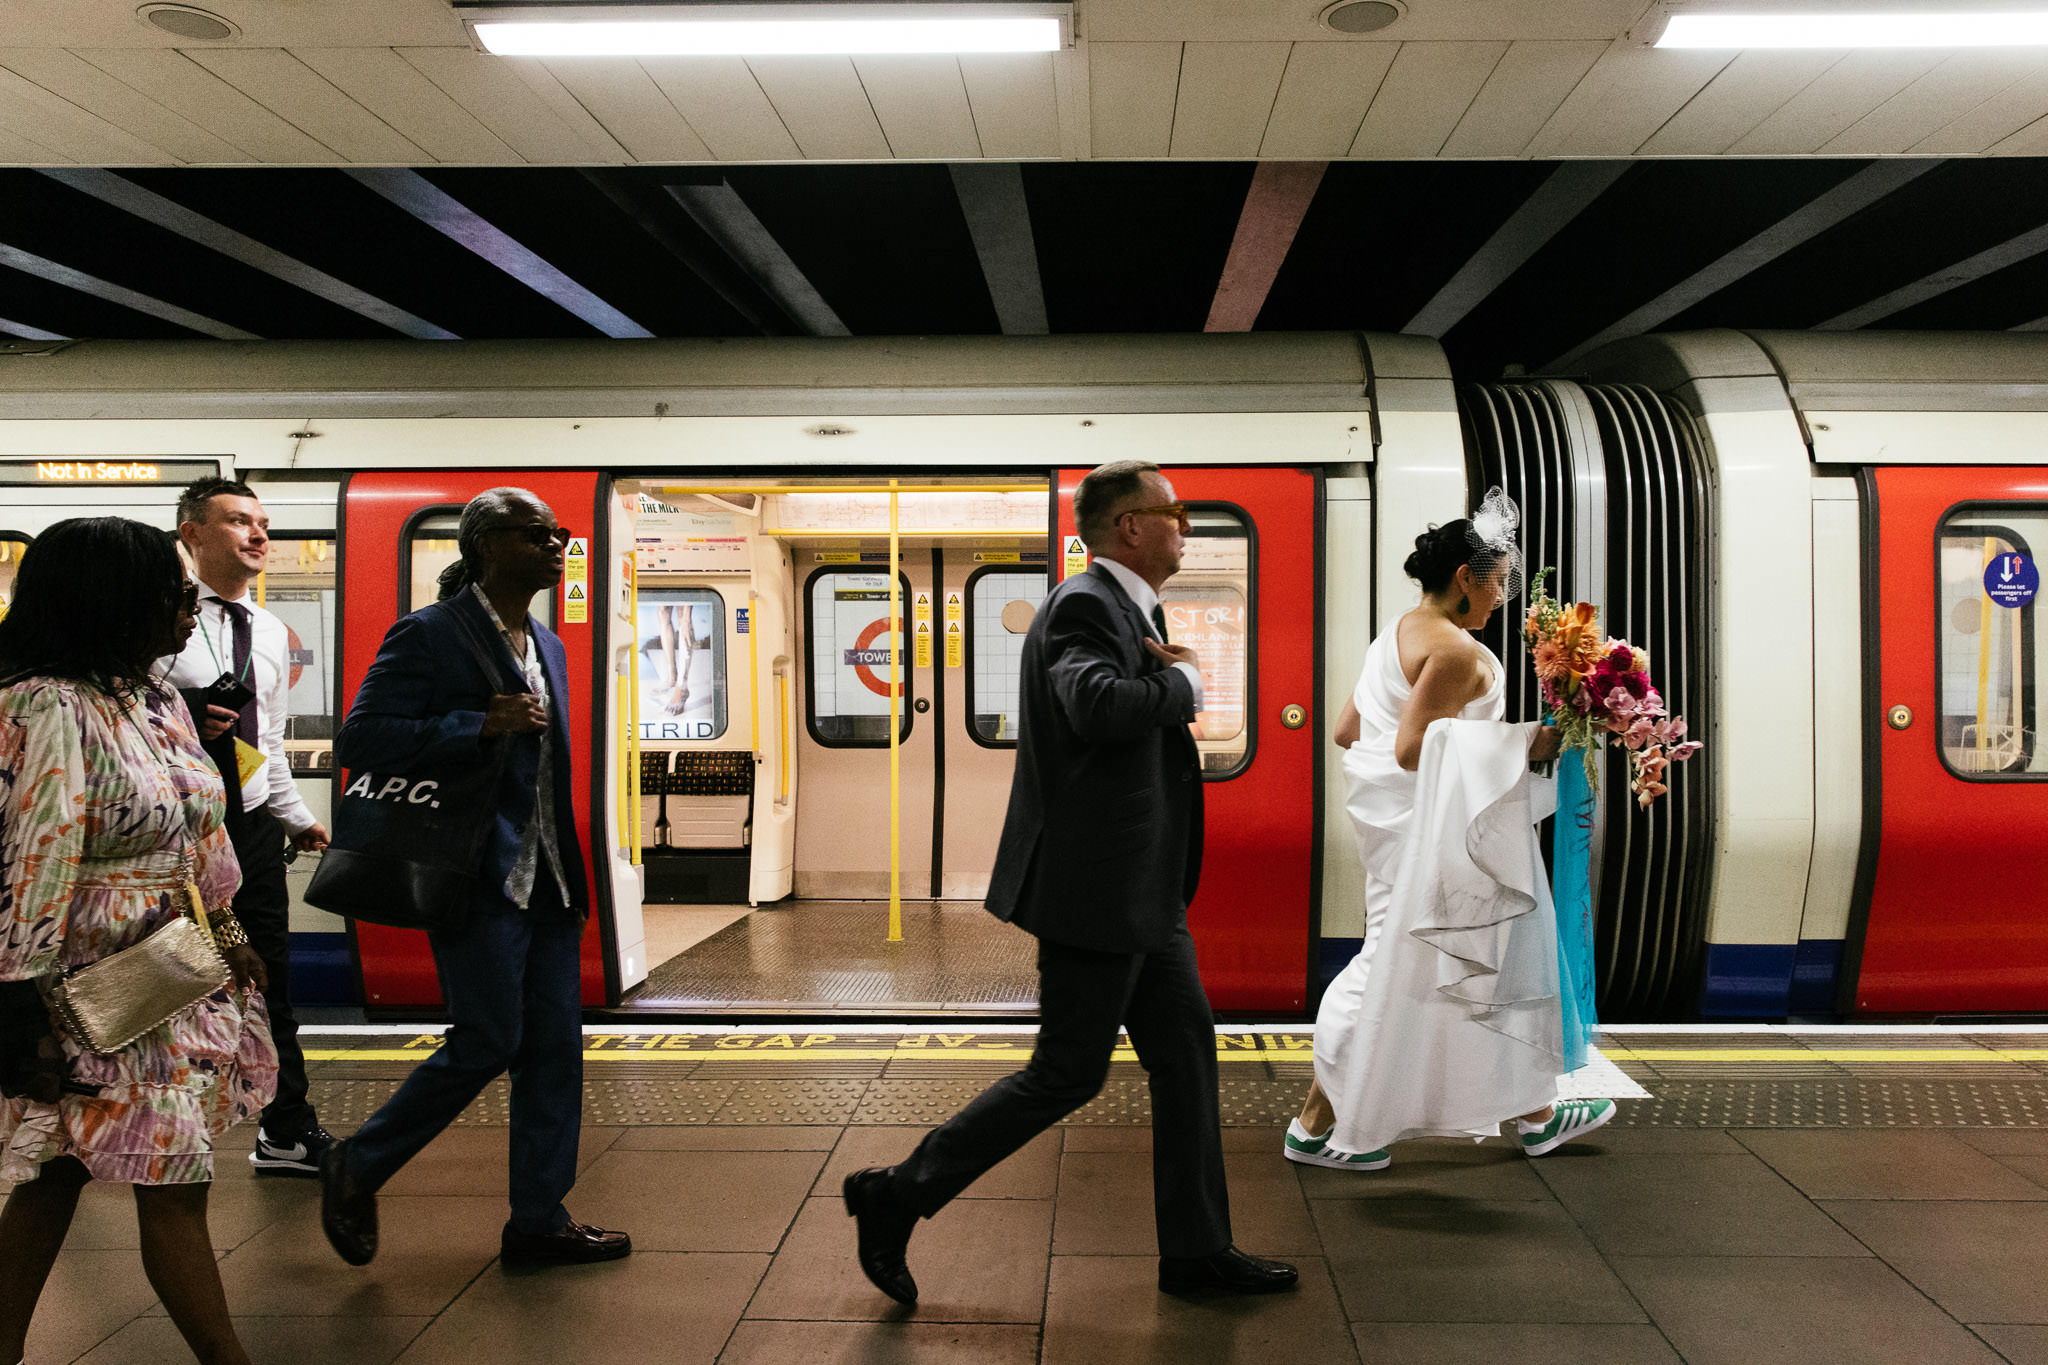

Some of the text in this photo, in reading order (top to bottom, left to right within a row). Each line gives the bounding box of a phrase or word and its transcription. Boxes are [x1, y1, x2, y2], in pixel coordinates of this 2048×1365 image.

[37, 462, 74, 479] Not
[95, 462, 158, 479] Service
[641, 503, 657, 513] THE
[857, 652, 891, 663] TOWE
[344, 771, 440, 808] A.P.C.
[589, 1034, 699, 1048] THE
[714, 1034, 838, 1048] GAP
[1216, 1034, 1315, 1050] MIN
